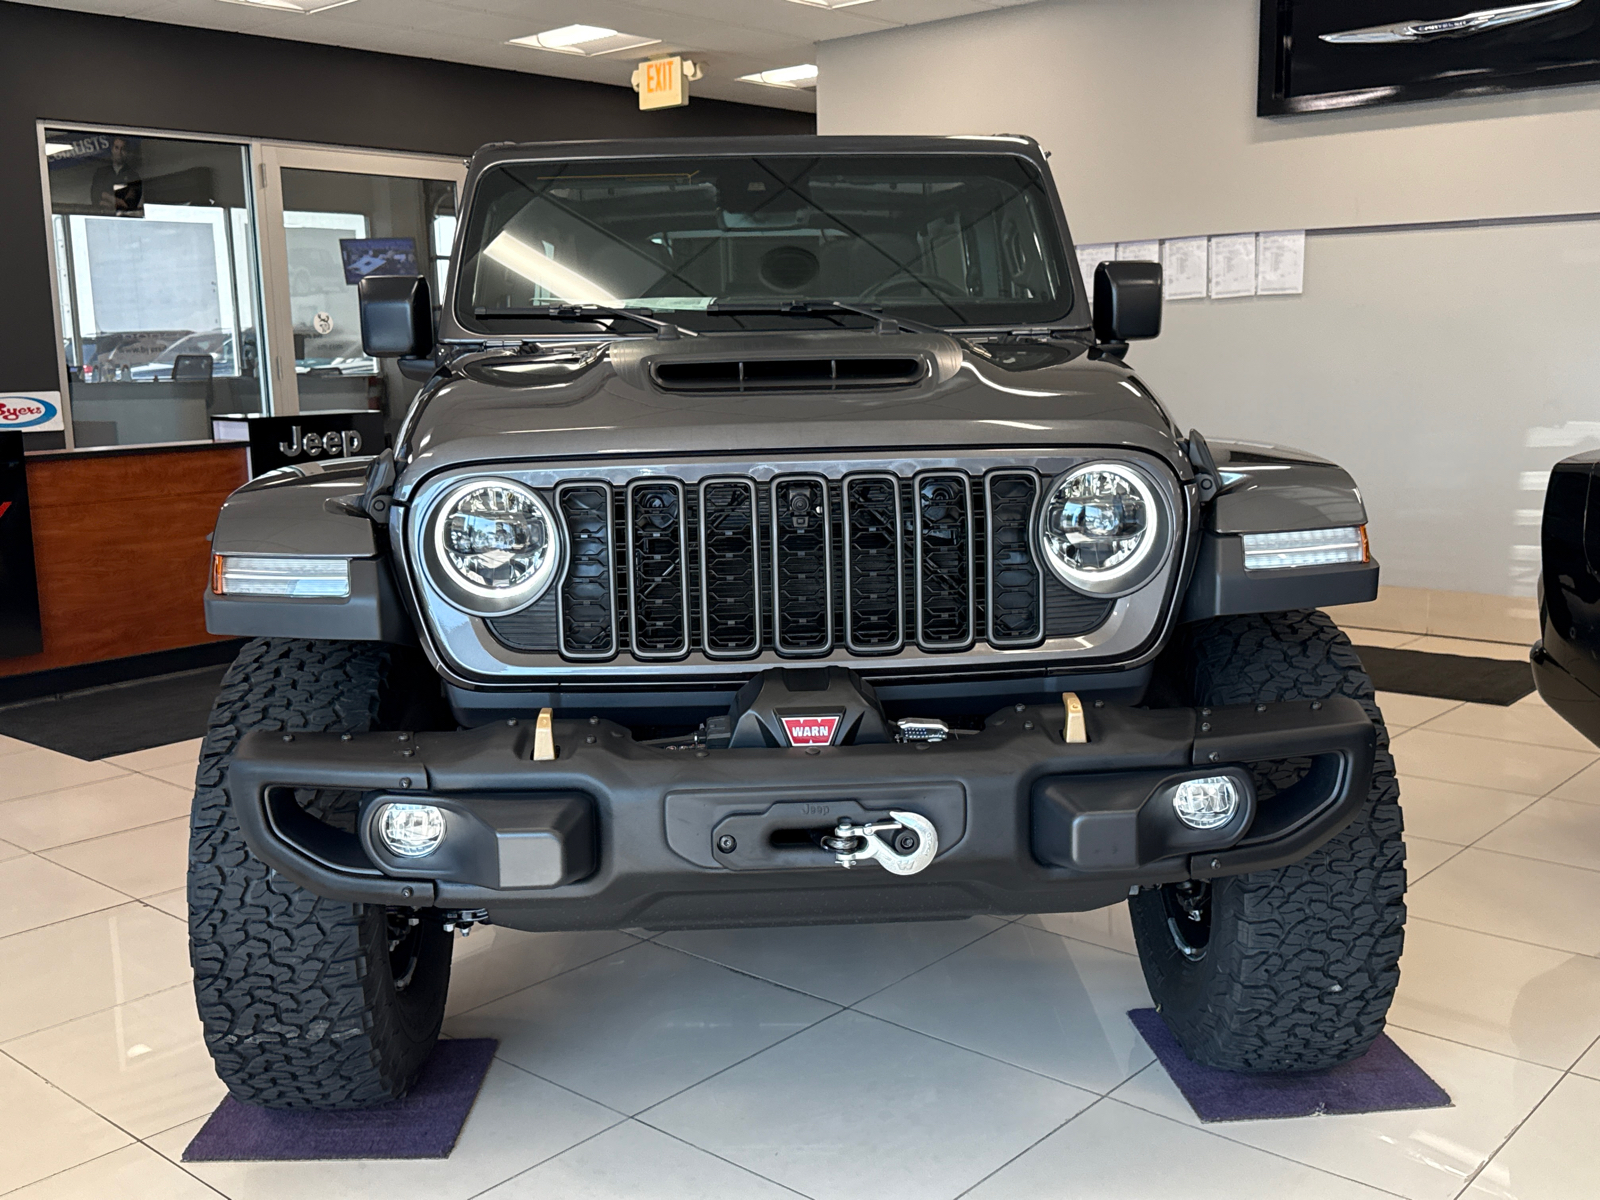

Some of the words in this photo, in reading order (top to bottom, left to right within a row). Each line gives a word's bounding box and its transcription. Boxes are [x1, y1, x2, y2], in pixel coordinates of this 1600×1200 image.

[646, 60, 674, 93] EXIT
[279, 425, 362, 458] Jeep
[792, 726, 829, 737] WARN
[802, 803, 830, 815] Jeep
